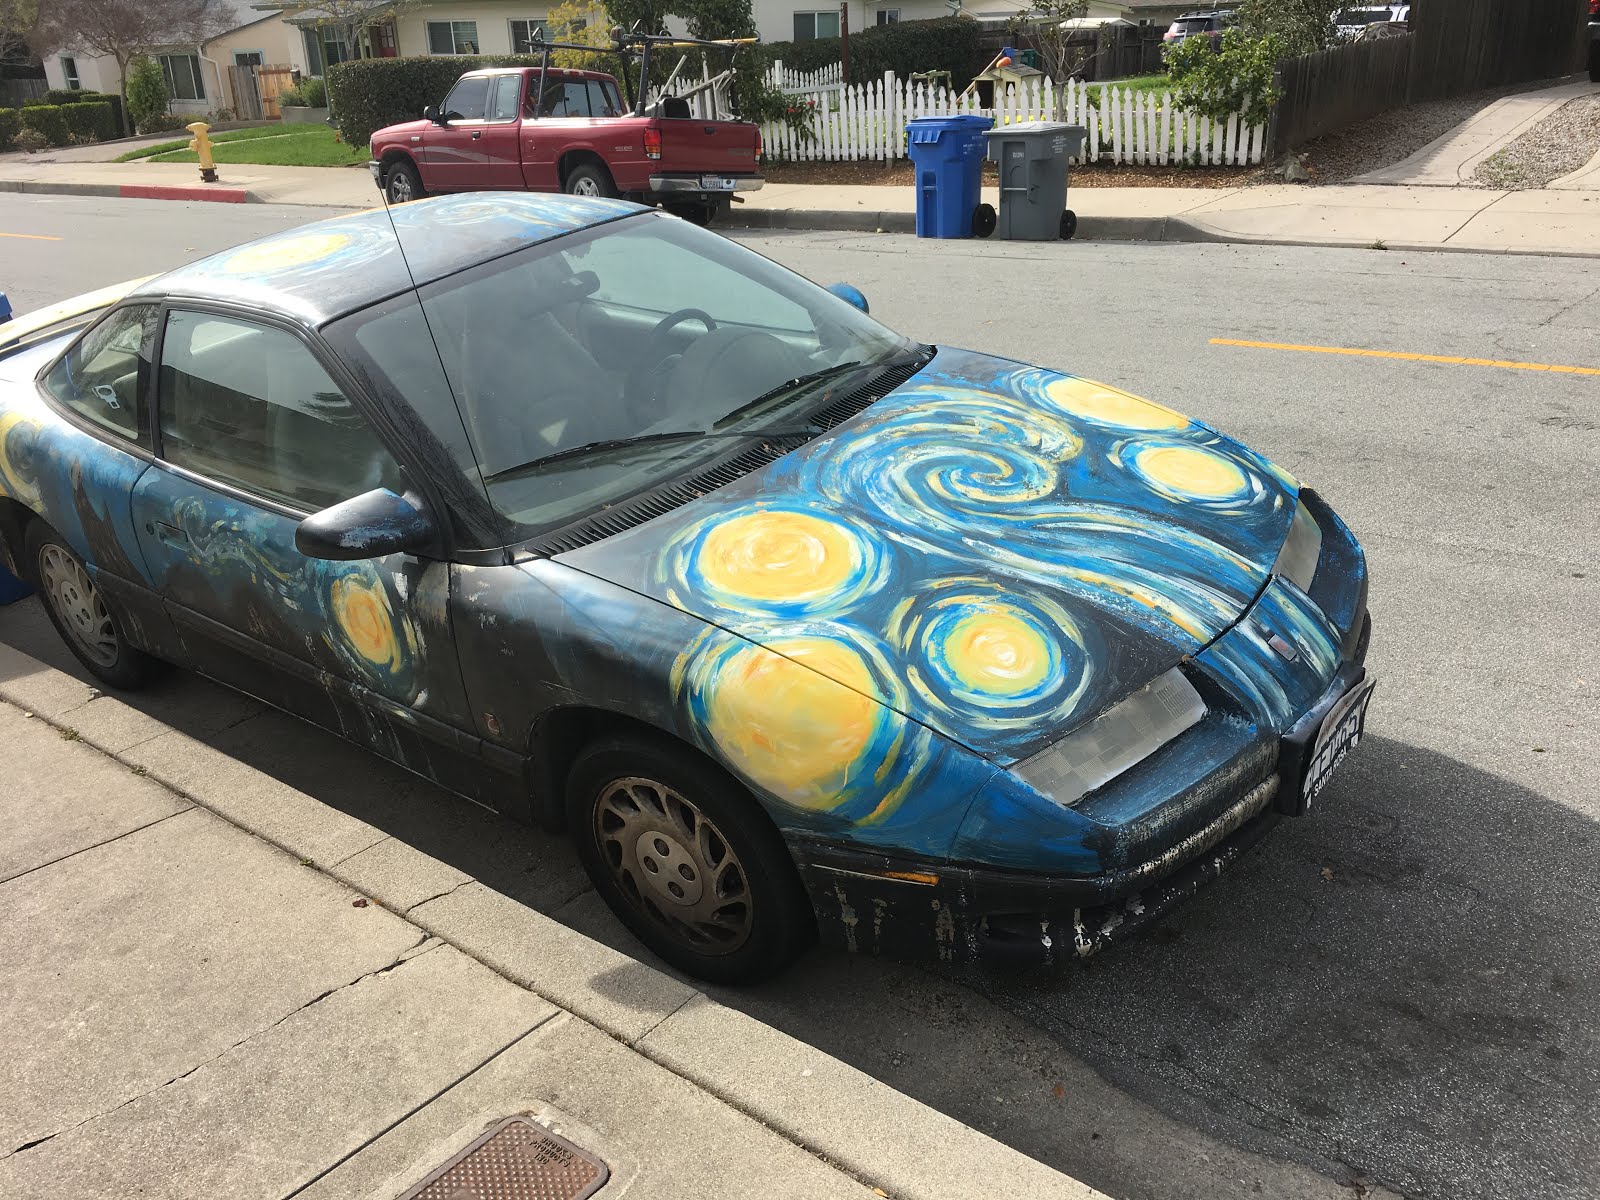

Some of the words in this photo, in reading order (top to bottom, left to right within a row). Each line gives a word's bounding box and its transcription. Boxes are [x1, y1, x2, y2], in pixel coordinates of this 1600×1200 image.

[1314, 767, 1333, 797] SANTA
[1333, 746, 1347, 772] ROSA
[529, 1140, 570, 1167] PRODUCTS
[534, 1153, 550, 1164] INC
[540, 1137, 574, 1159] BROOKS
